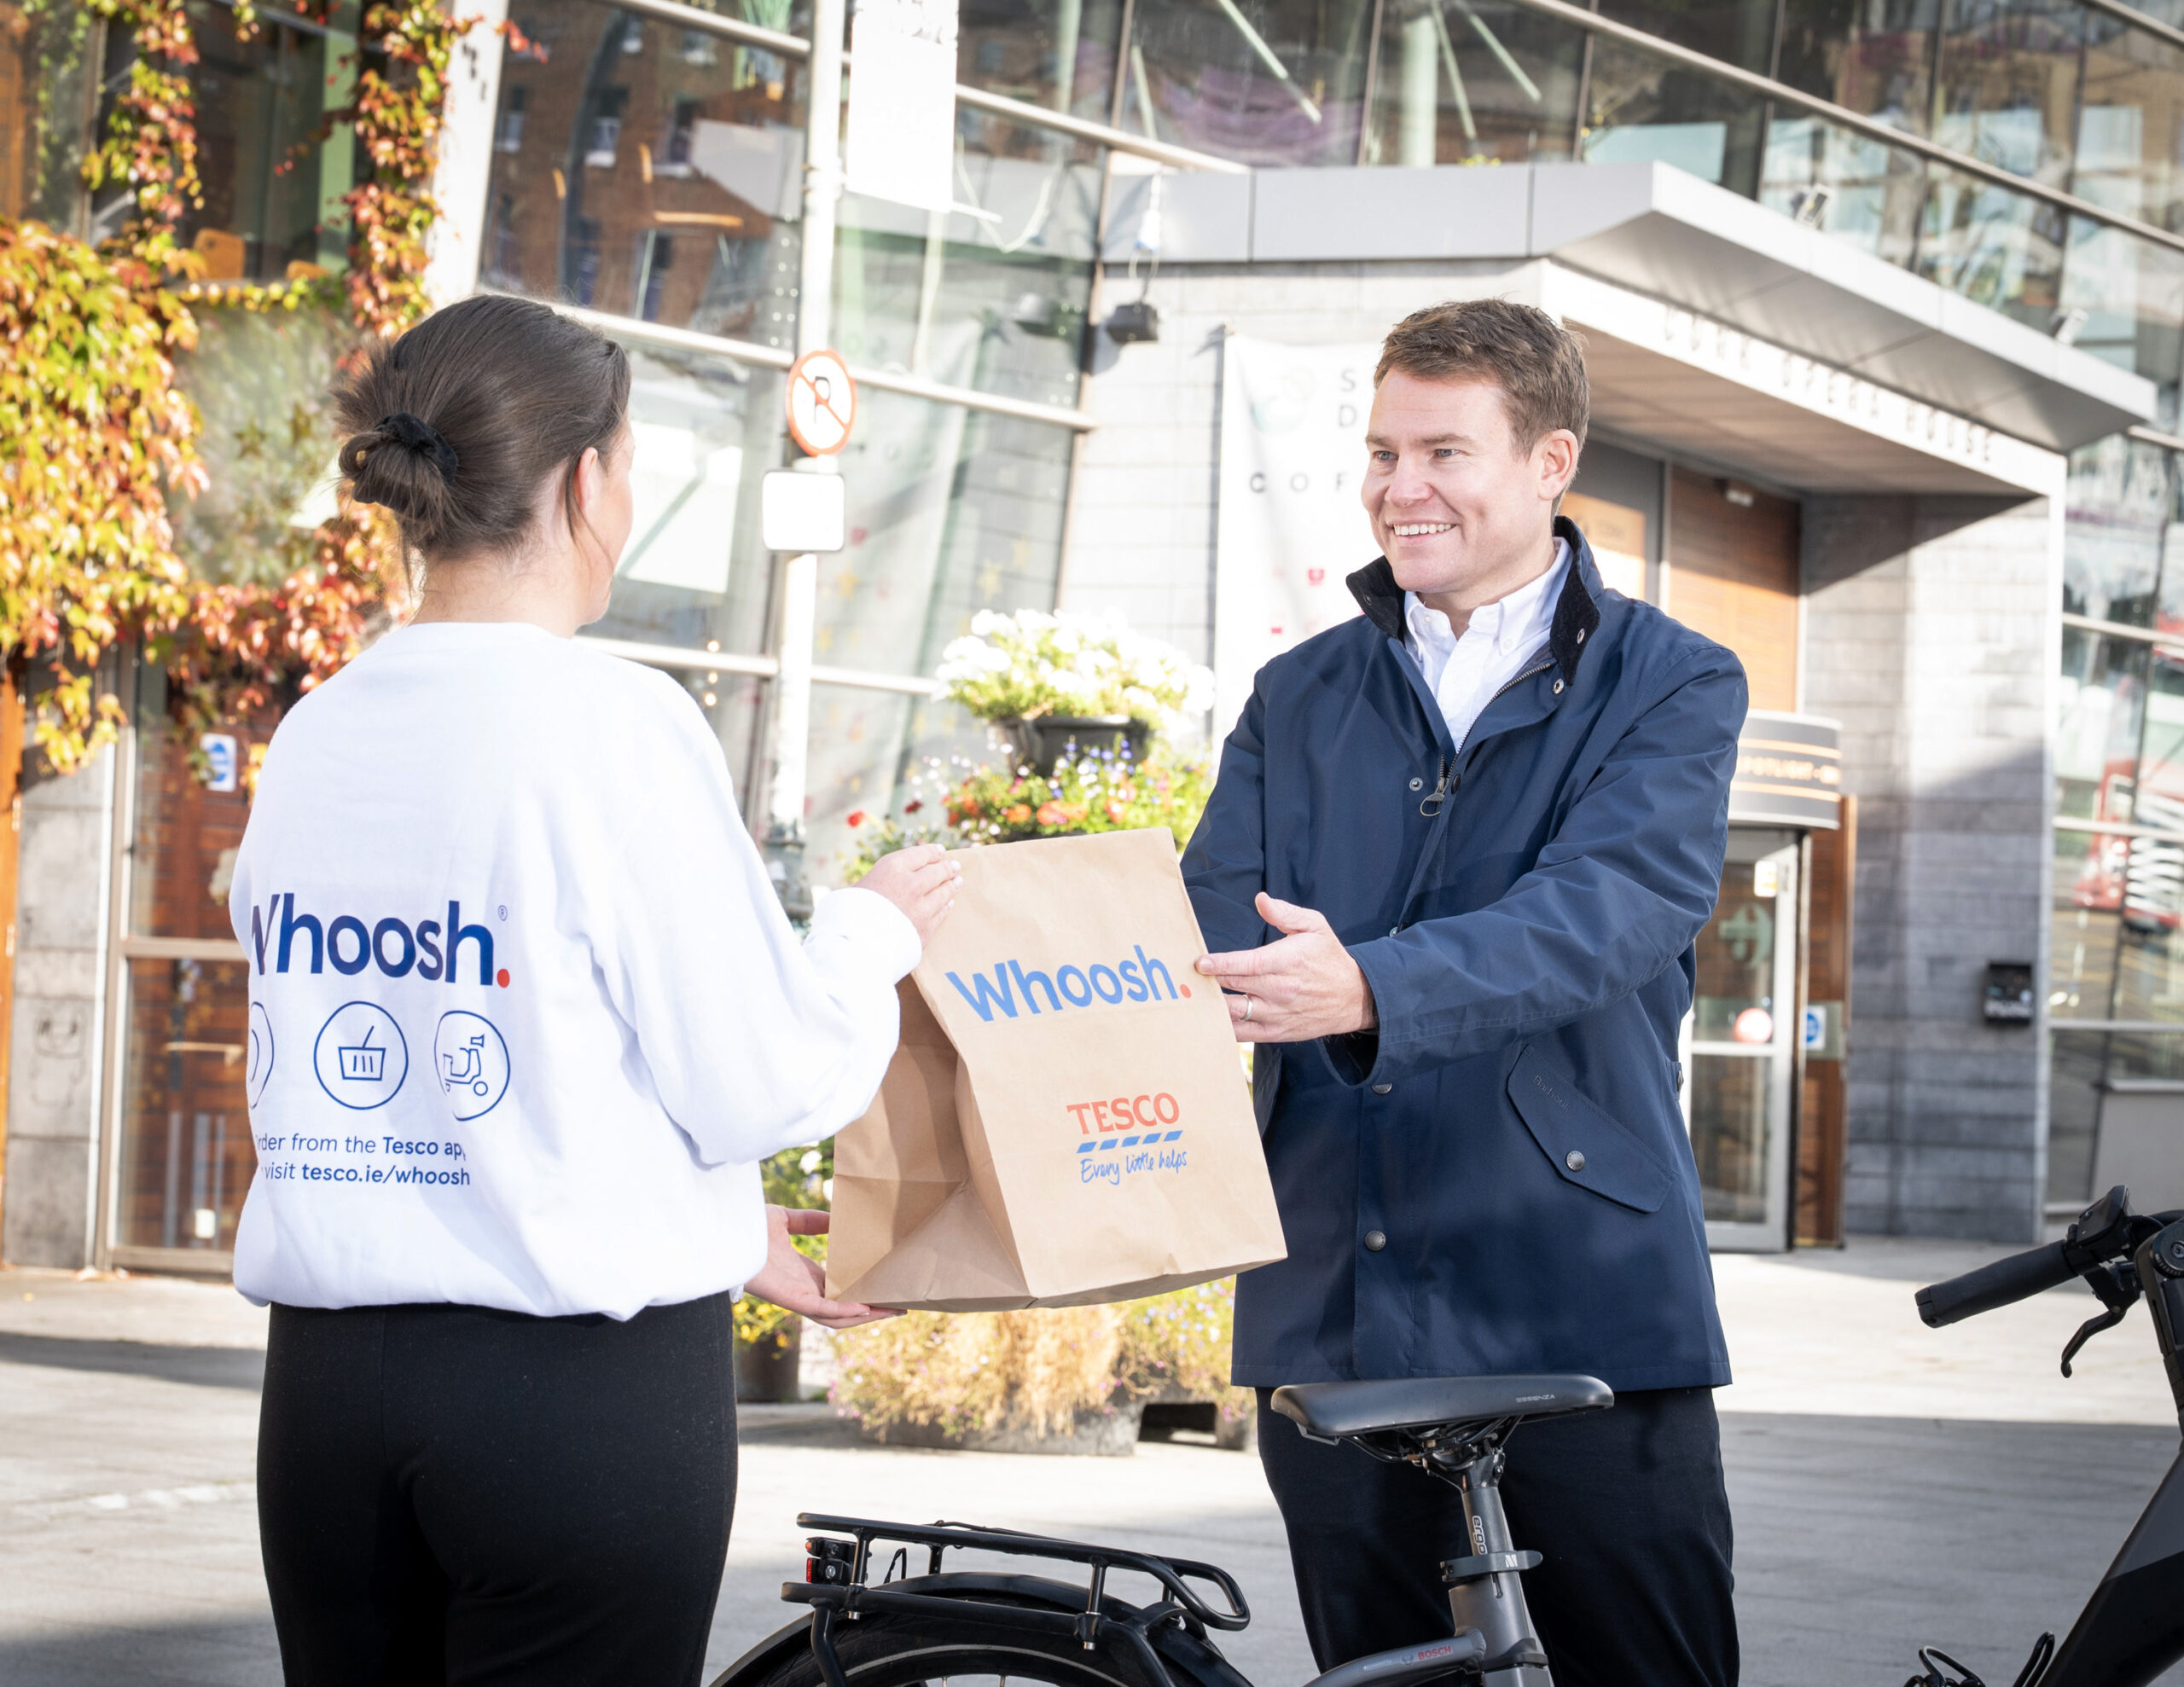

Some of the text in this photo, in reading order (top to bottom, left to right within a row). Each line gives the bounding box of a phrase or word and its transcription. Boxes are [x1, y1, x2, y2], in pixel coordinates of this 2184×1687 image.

[944, 944, 1192, 1022] Whoosh.
[1066, 1093, 1180, 1135] TESCO
[255, 1133, 286, 1151] rder
[291, 1133, 338, 1152] from
[345, 1135, 376, 1153] the
[383, 1136, 439, 1155] Tesco
[264, 1162, 296, 1180] visit
[302, 1163, 470, 1186] tesco.ie/whoosh
[1080, 1149, 1188, 1186] Every little helps
[1417, 1644, 1453, 1661] BOSCH
